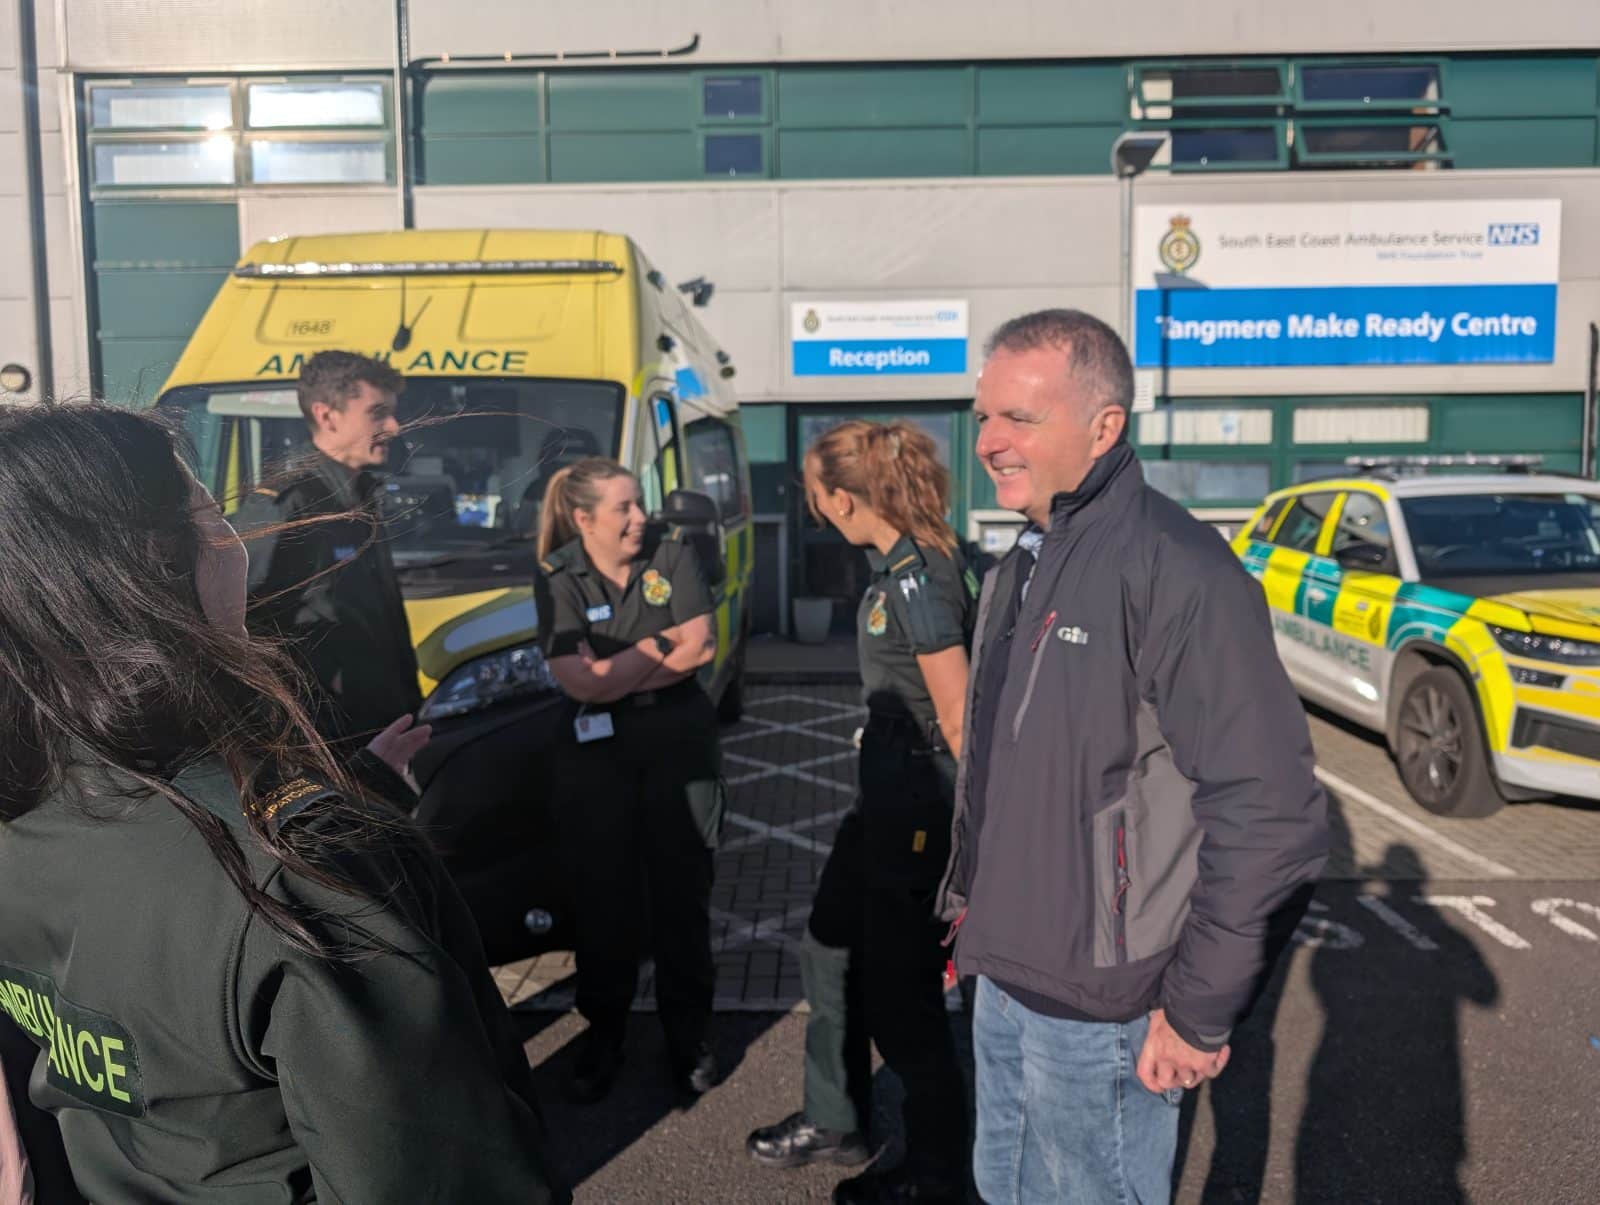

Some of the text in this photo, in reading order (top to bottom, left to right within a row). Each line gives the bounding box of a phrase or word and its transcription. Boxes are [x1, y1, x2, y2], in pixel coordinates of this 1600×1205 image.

[1218, 230, 1484, 248] South East Coast Ambulance Service
[1489, 223, 1539, 245] NHS
[1155, 311, 1538, 345] Tangmere Make Ready Centre
[256, 350, 529, 376] AANCE
[829, 346, 930, 371] Reception
